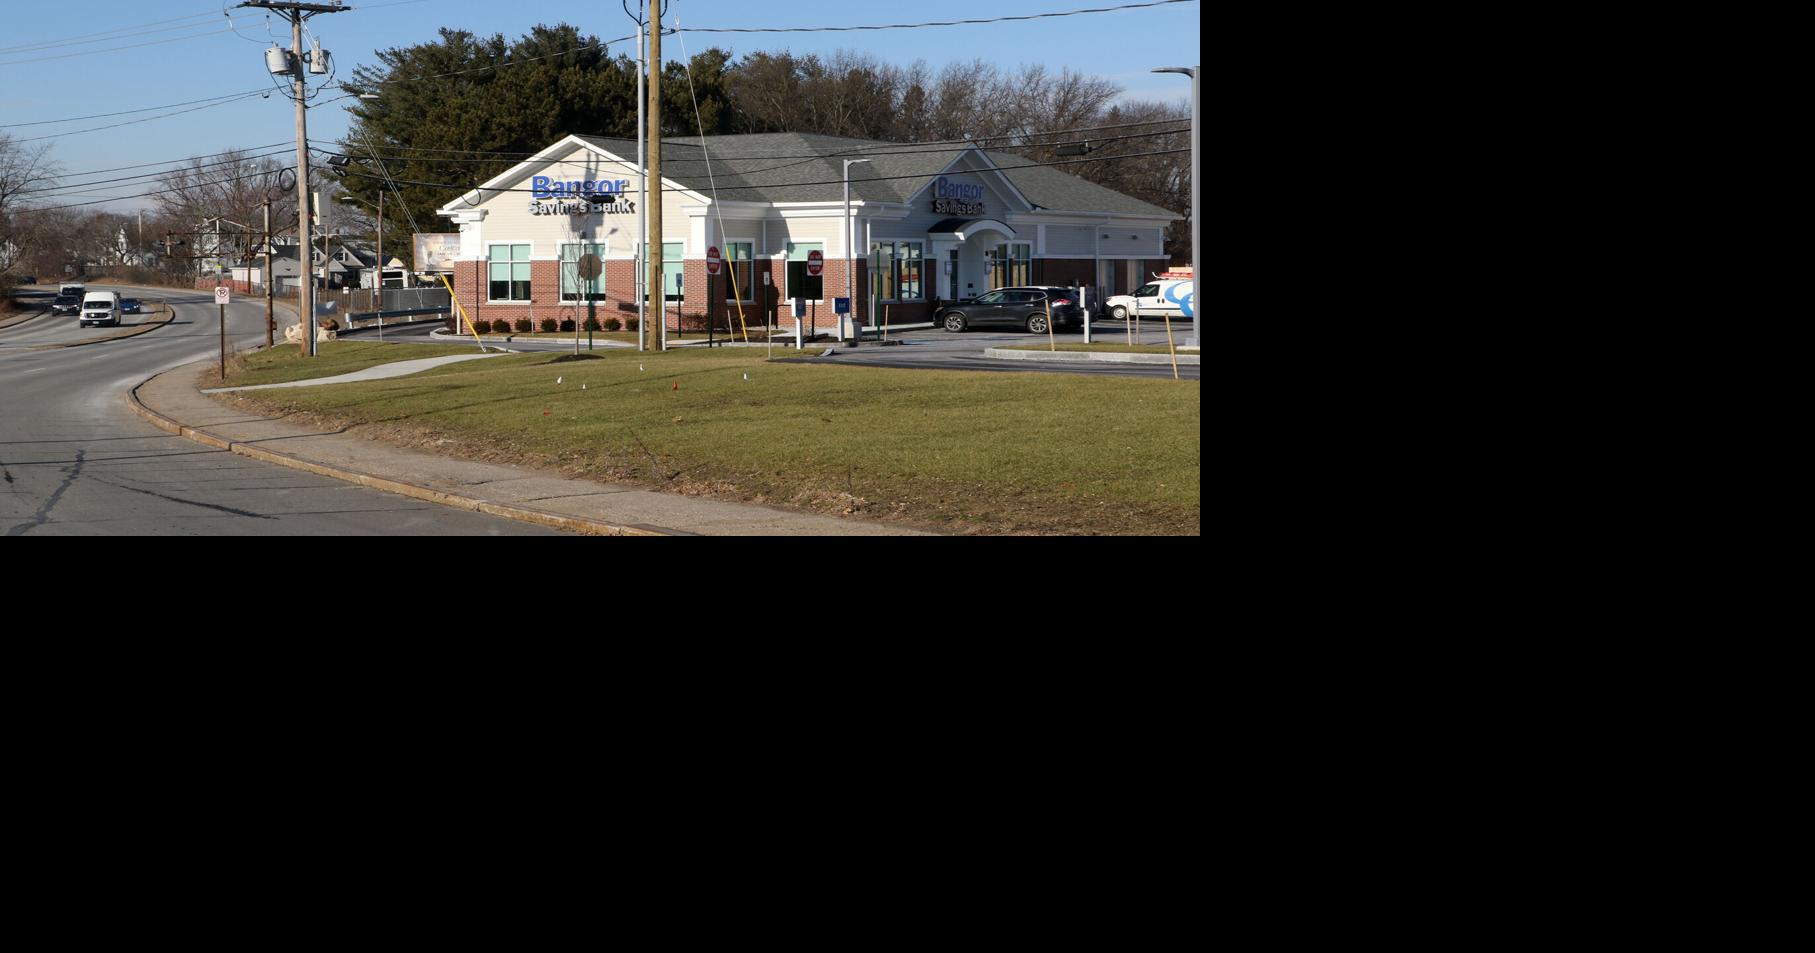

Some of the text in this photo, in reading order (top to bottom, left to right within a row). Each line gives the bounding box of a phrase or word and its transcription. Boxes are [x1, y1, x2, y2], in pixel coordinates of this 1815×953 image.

[532, 175, 626, 199] Bangor
[937, 176, 985, 200] Bangor
[528, 200, 588, 215] Savings
[935, 199, 966, 215] Savings
